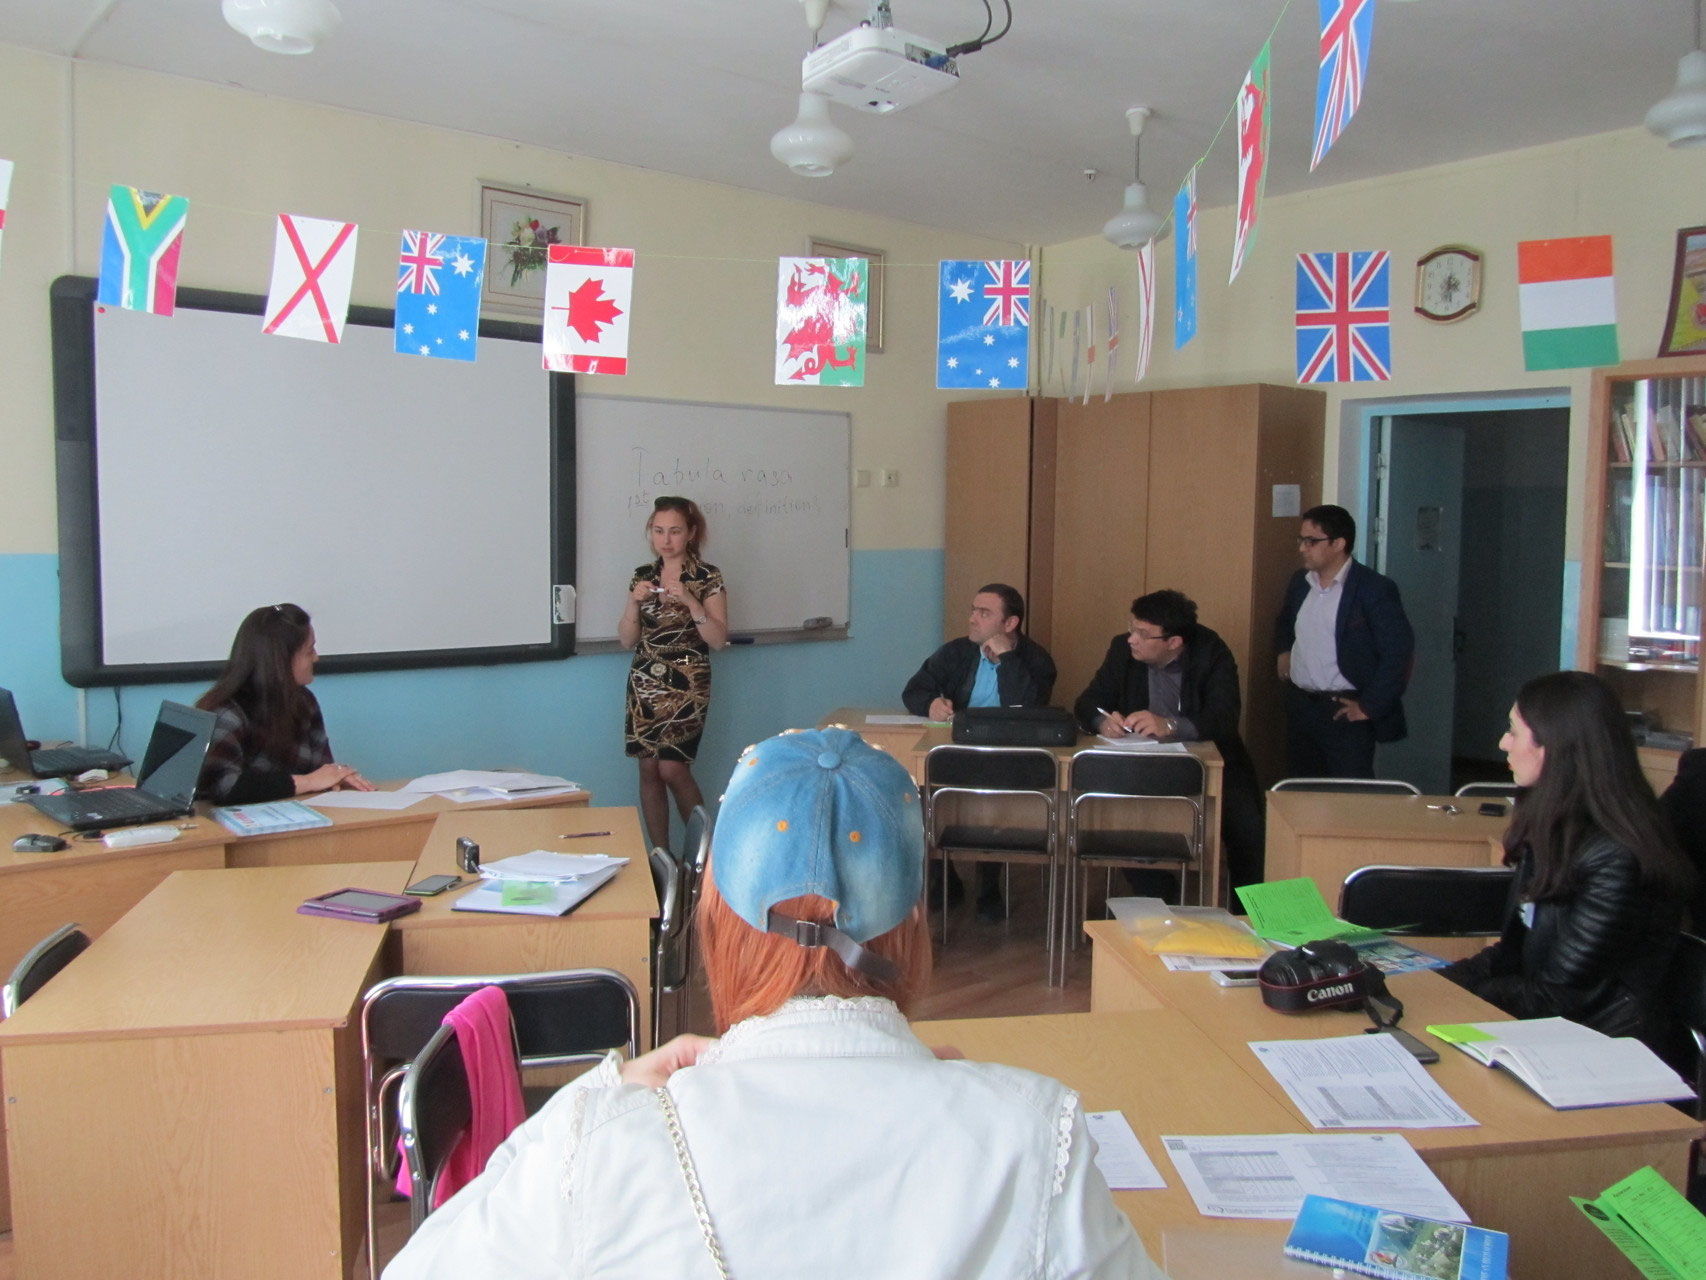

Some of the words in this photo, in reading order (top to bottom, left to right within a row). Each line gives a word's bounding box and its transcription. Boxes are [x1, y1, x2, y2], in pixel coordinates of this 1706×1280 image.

[631, 446, 727, 487] Tabula
[741, 468, 793, 487] rasa
[1306, 982, 1354, 1002] Canon
